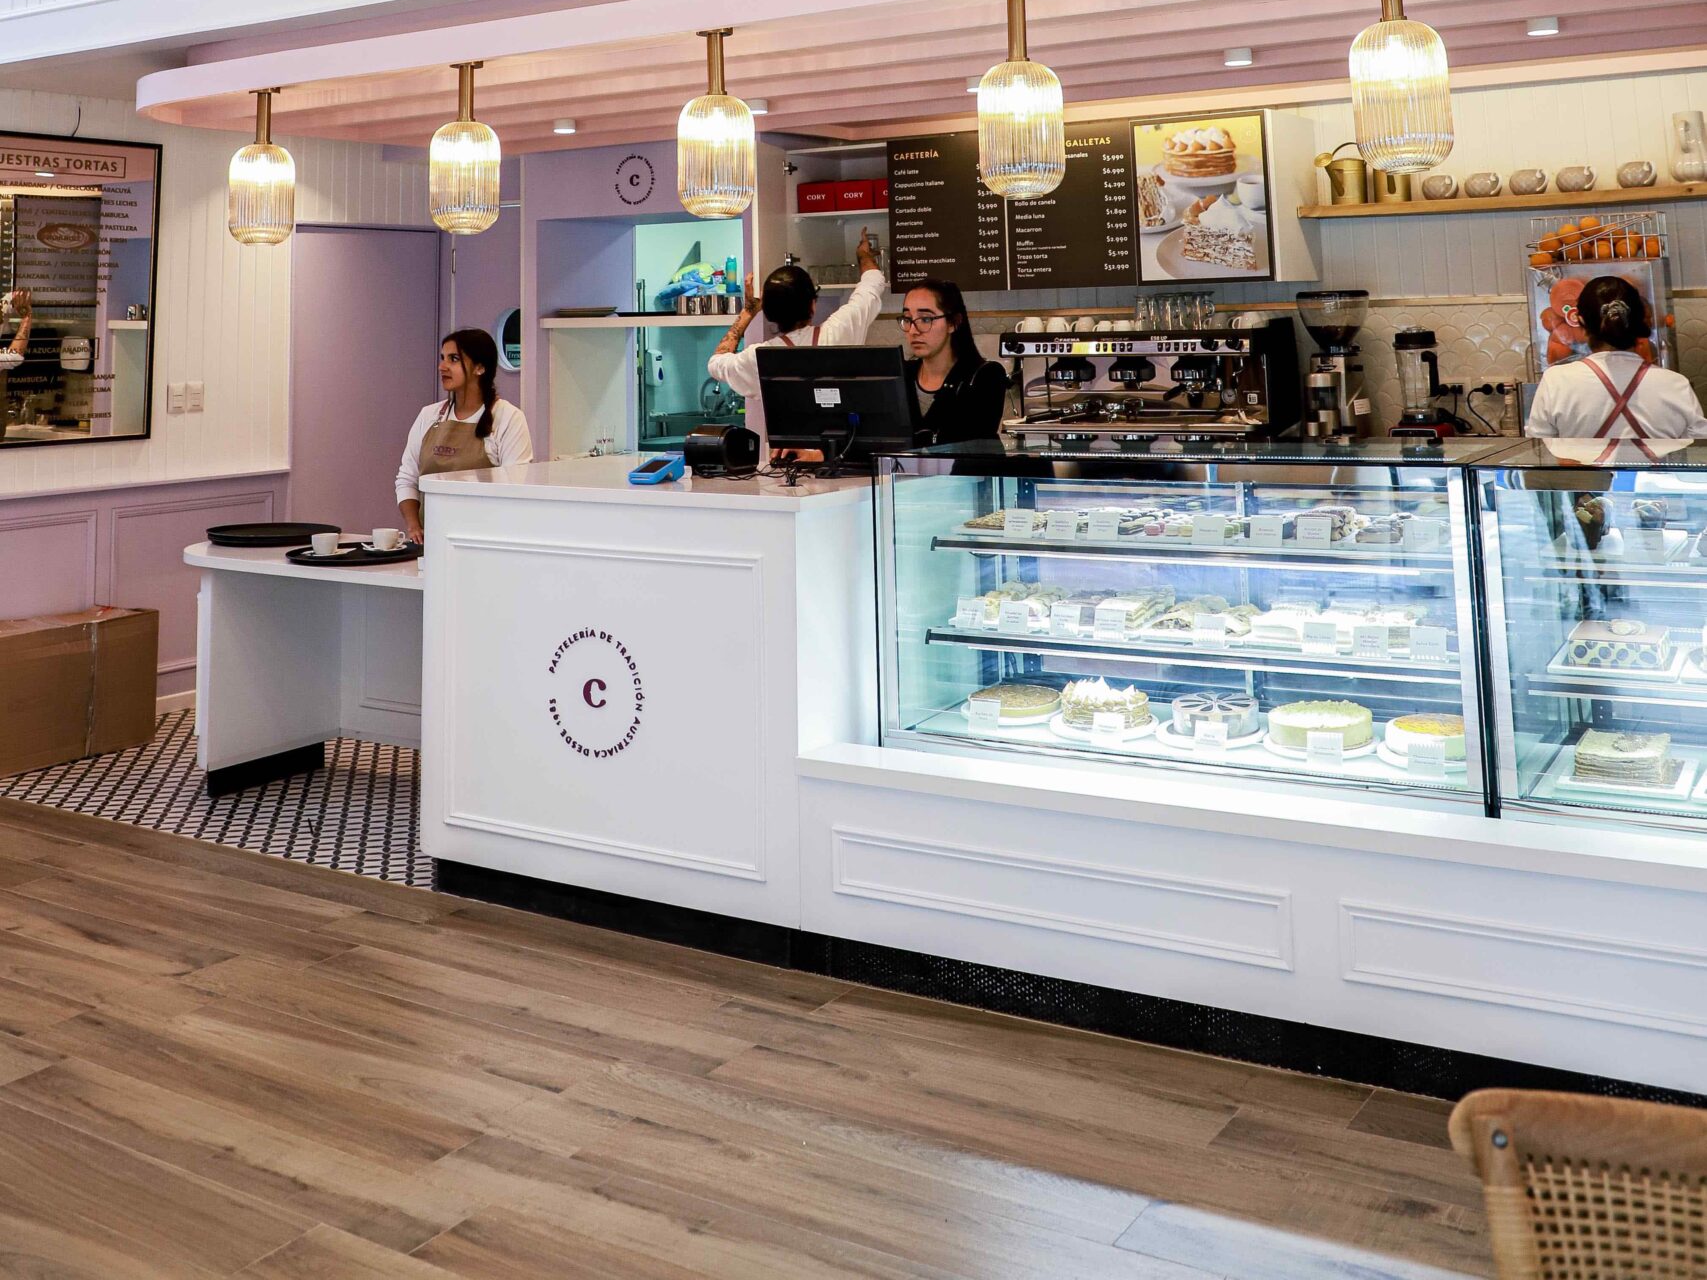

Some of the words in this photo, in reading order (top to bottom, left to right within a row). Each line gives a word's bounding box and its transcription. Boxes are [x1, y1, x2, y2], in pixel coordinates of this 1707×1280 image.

[1065, 136, 1111, 147] GALLETAS
[65, 158, 118, 173] TORTAS
[894, 149, 939, 160] CAFETERÍA
[1102, 167, 1125, 175] $6.990
[600, 631, 613, 643] DE
[549, 626, 596, 674] PASTELERÍA
[615, 641, 645, 712] TRADICIÓN
[583, 678, 606, 708] C
[560, 728, 590, 757] DESDE
[594, 716, 641, 758] AUSTRIACA
